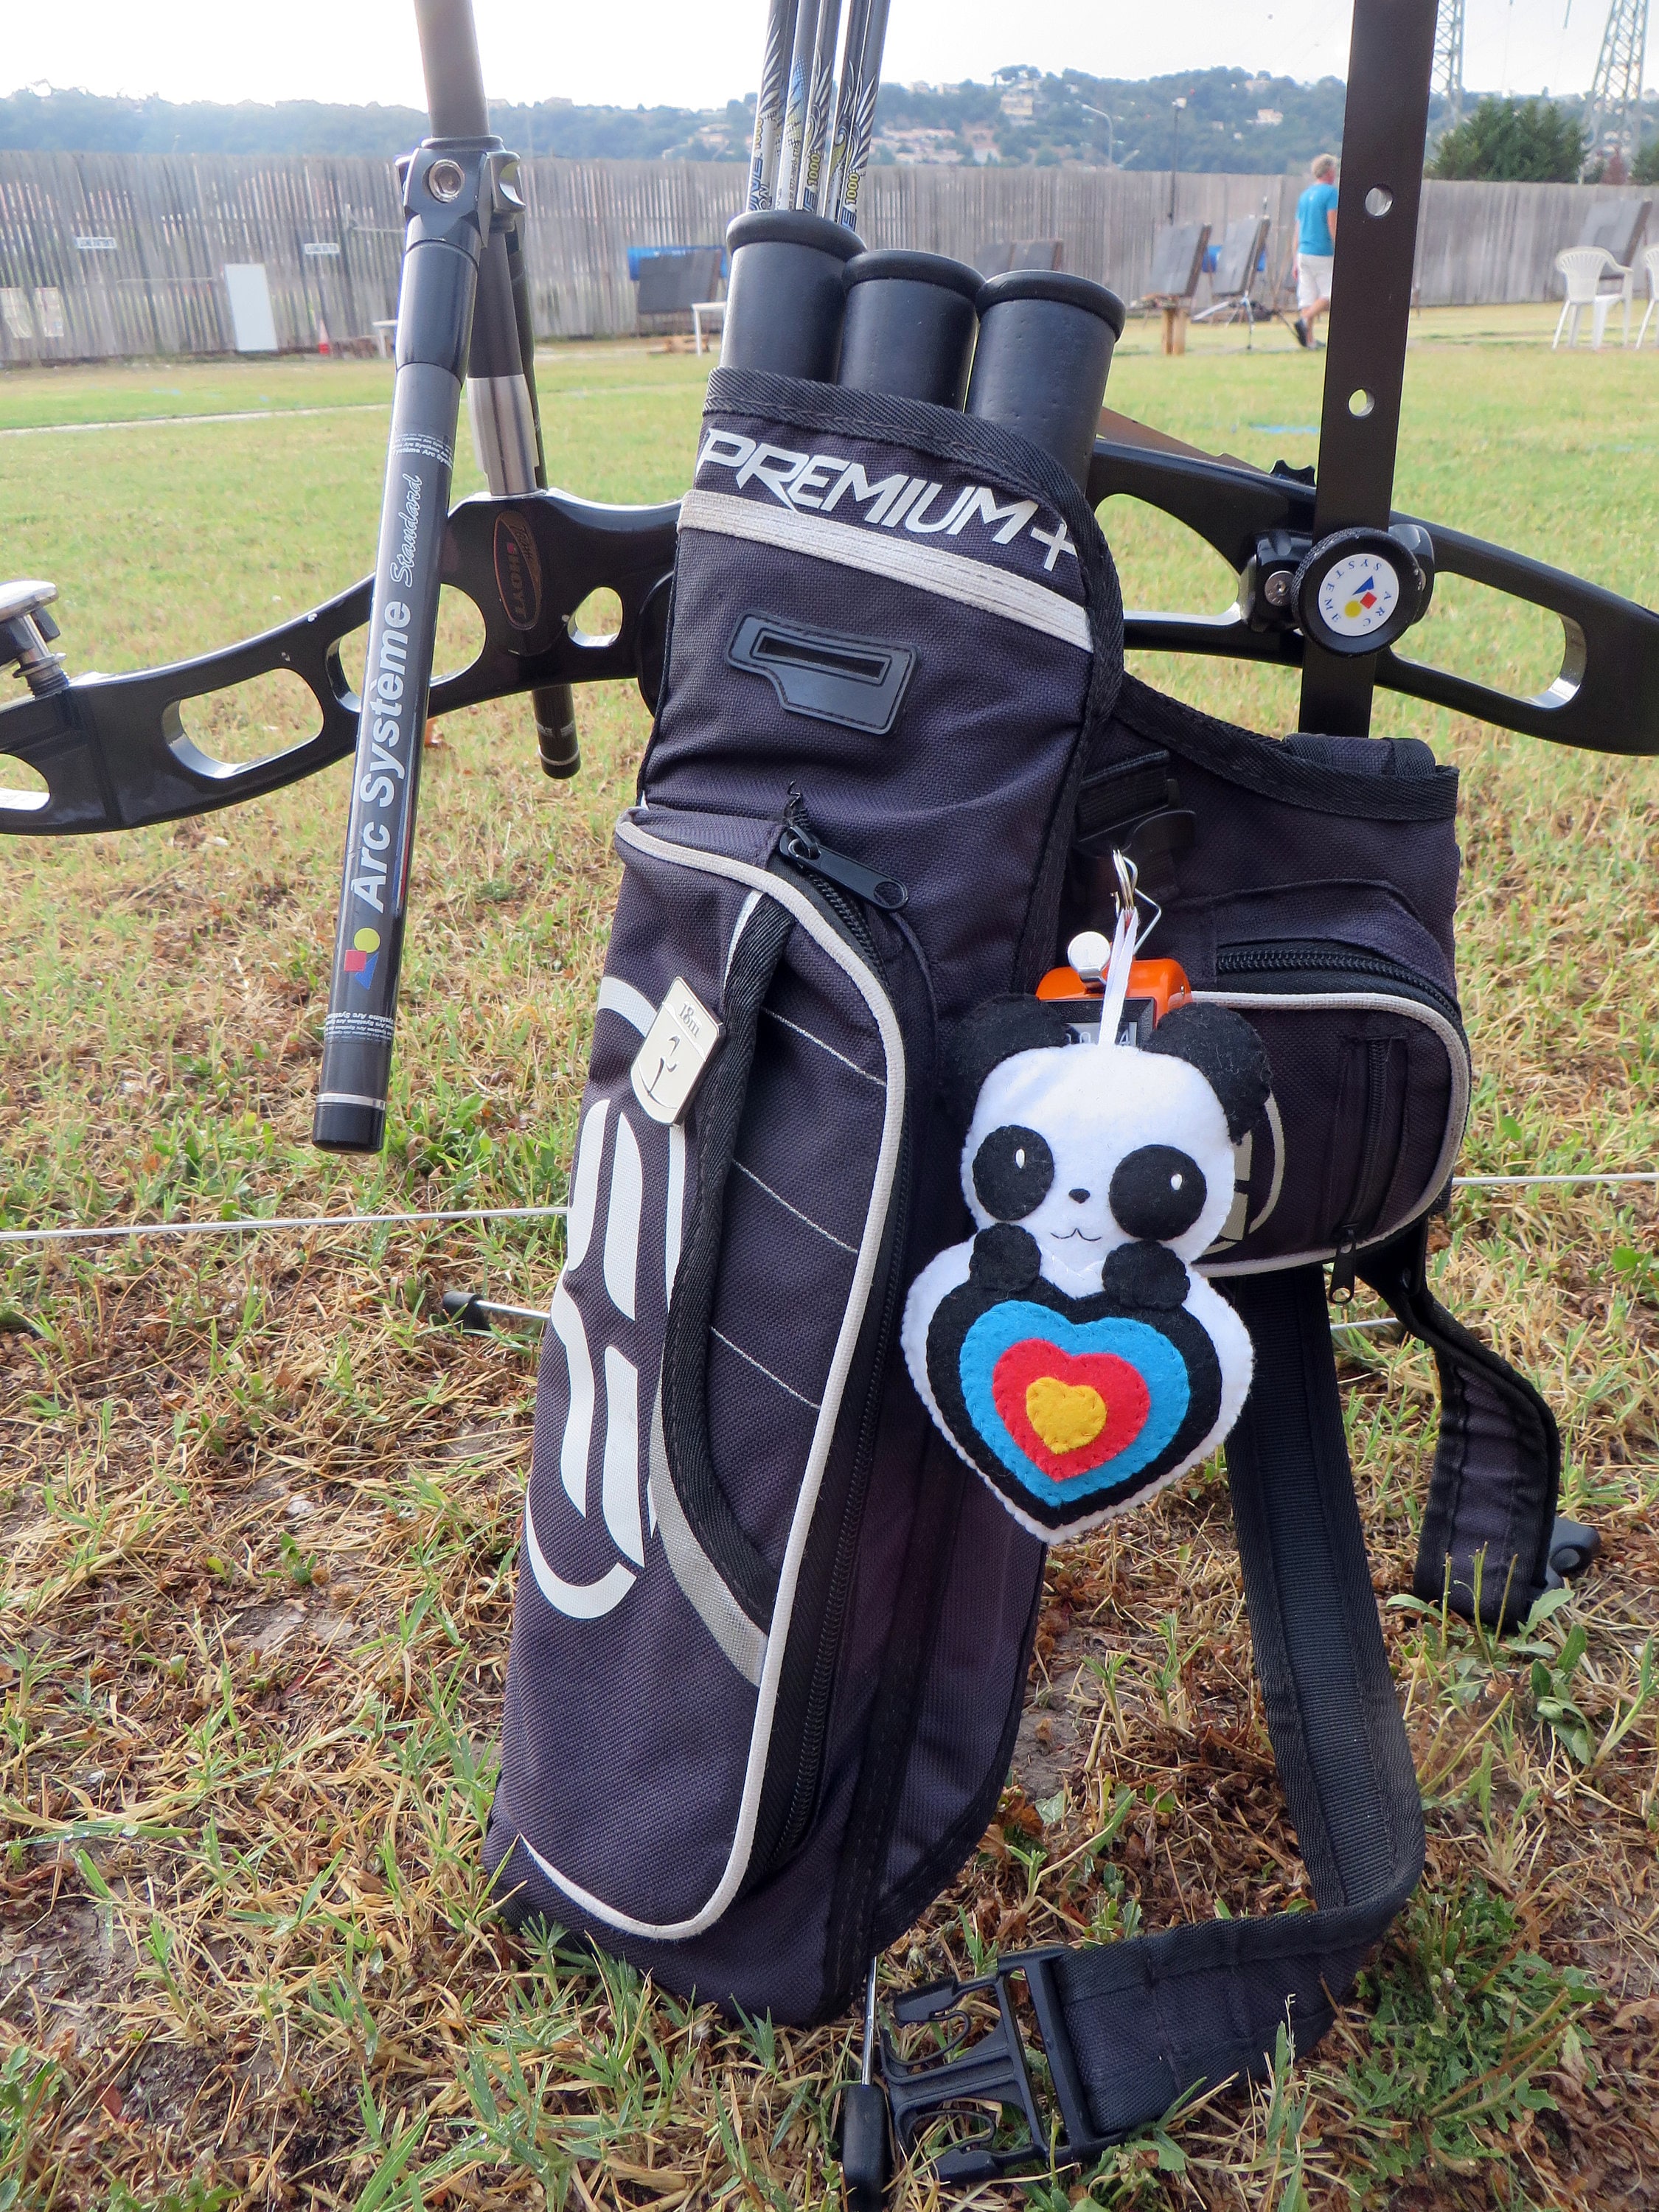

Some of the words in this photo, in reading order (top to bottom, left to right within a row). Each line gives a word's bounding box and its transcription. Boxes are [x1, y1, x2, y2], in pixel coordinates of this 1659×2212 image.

[807, 153, 821, 187] 1000
[844, 172, 860, 205] 1000
[390, 473, 423, 588] Standard
[695, 428, 1078, 571] PREMIUM+
[1363, 591, 1392, 627] ARC
[360, 600, 411, 807] Système
[350, 821, 392, 914] Arc
[678, 1001, 701, 1039] 18m
